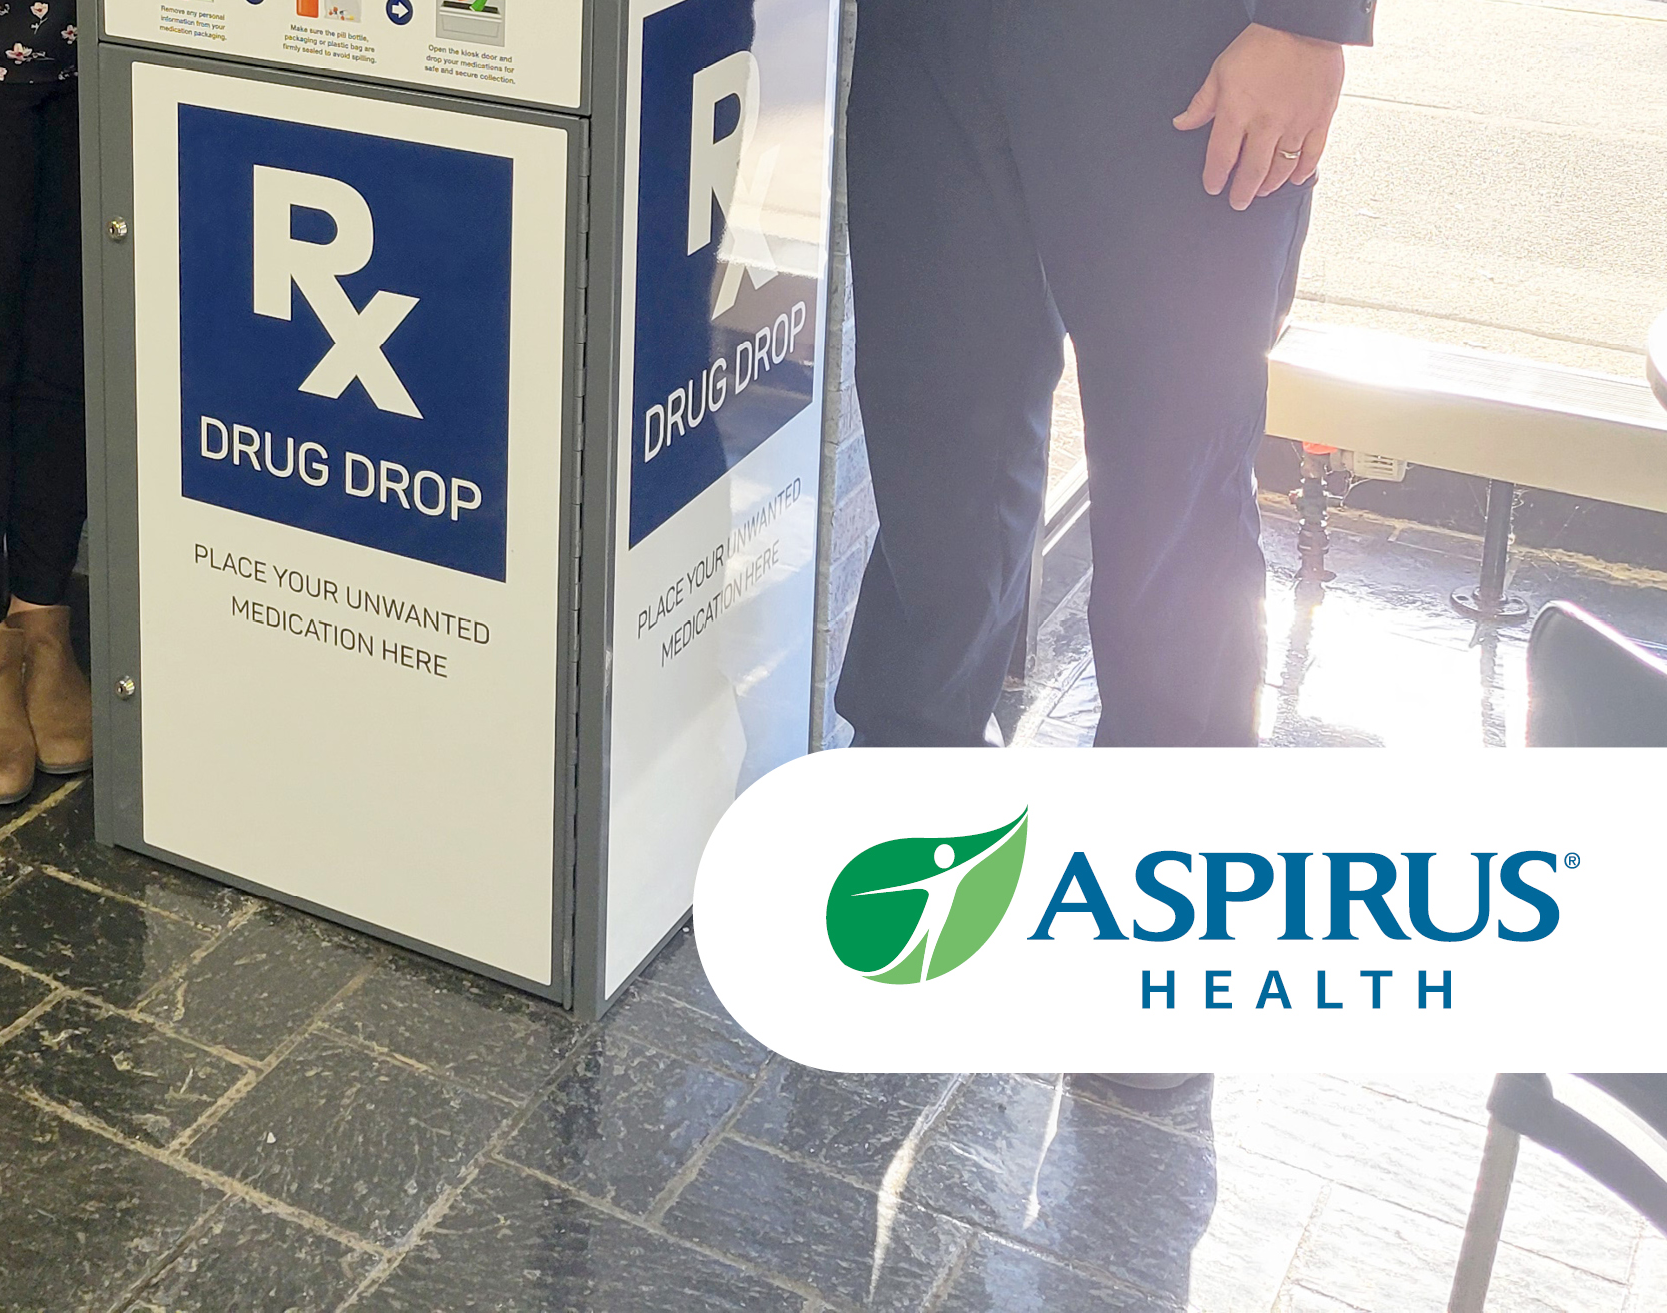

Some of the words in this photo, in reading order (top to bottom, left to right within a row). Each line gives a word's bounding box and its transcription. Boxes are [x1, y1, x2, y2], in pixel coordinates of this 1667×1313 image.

[161, 5, 185, 14] Remove
[187, 10, 197, 18] any
[199, 12, 225, 20] personal
[161, 15, 195, 26] information
[196, 20, 211, 28] from
[159, 25, 193, 36] medication
[291, 24, 308, 32] Make
[283, 42, 301, 52] firmly
[302, 46, 323, 55] sealed
[333, 51, 351, 60] avoid
[285, 34, 317, 45] packaging
[327, 40, 349, 48] plastic
[351, 44, 363, 52] bag
[428, 44, 447, 53] Open
[449, 47, 459, 55] the
[461, 49, 479, 58] kiosk
[481, 52, 497, 60] door
[426, 55, 442, 64] drop
[461, 60, 503, 72] medications
[455, 70, 478, 78] secure
[479, 74, 516, 84] collection.
[644, 357, 727, 464] DRUG
[735, 300, 806, 395] DROP
[201, 415, 329, 487] DRUG
[345, 452, 483, 522] DROP
[637, 577, 684, 639] PLACE
[686, 543, 724, 597] YOUR
[726, 477, 802, 559] UNWANTED
[194, 543, 267, 584] PLACE
[272, 565, 338, 604] YOUR
[346, 585, 491, 646] UNWANTED
[661, 578, 743, 668] MEDICATION
[744, 539, 780, 590] HERE
[231, 596, 374, 657] MEDICATION
[382, 639, 448, 678] HERE
